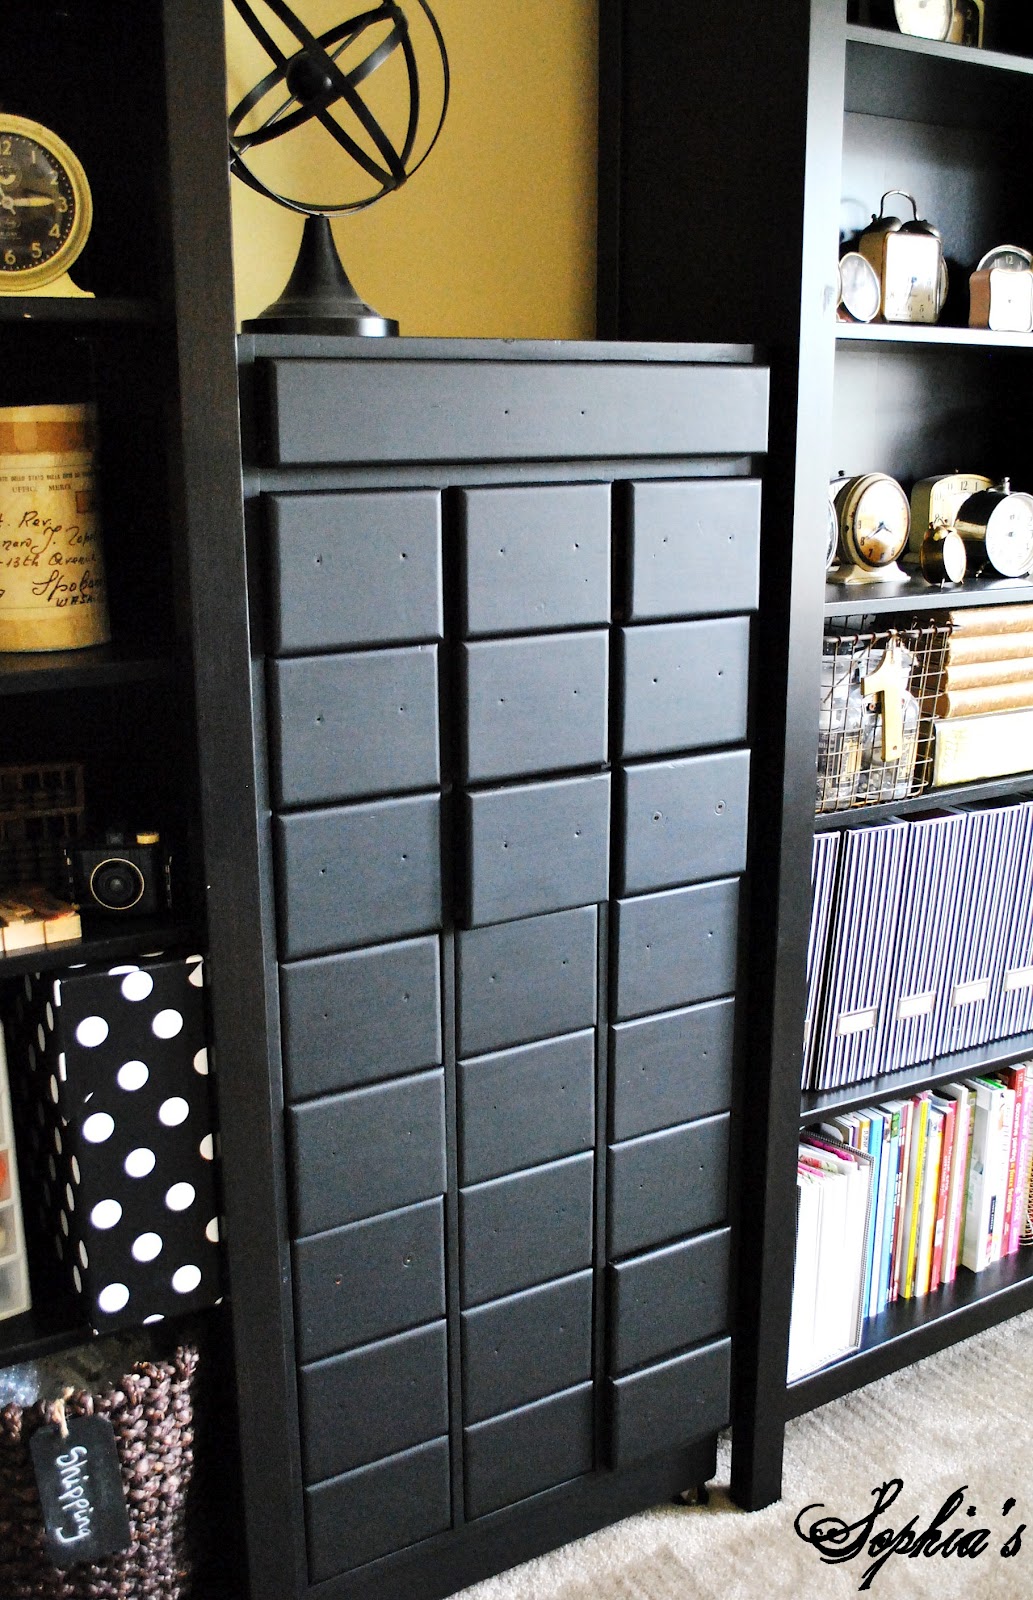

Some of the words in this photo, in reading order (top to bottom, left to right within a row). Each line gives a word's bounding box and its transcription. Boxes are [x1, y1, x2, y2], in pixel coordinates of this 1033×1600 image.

[58, 196, 68, 213] 3
[49, 223, 60, 239] 4
[4, 249, 17, 266] 6
[31, 242, 43, 259] 5
[1005, 255, 1013, 265] 12
[960, 480, 968, 491] 12
[55, 1445, 93, 1543] Shipping
